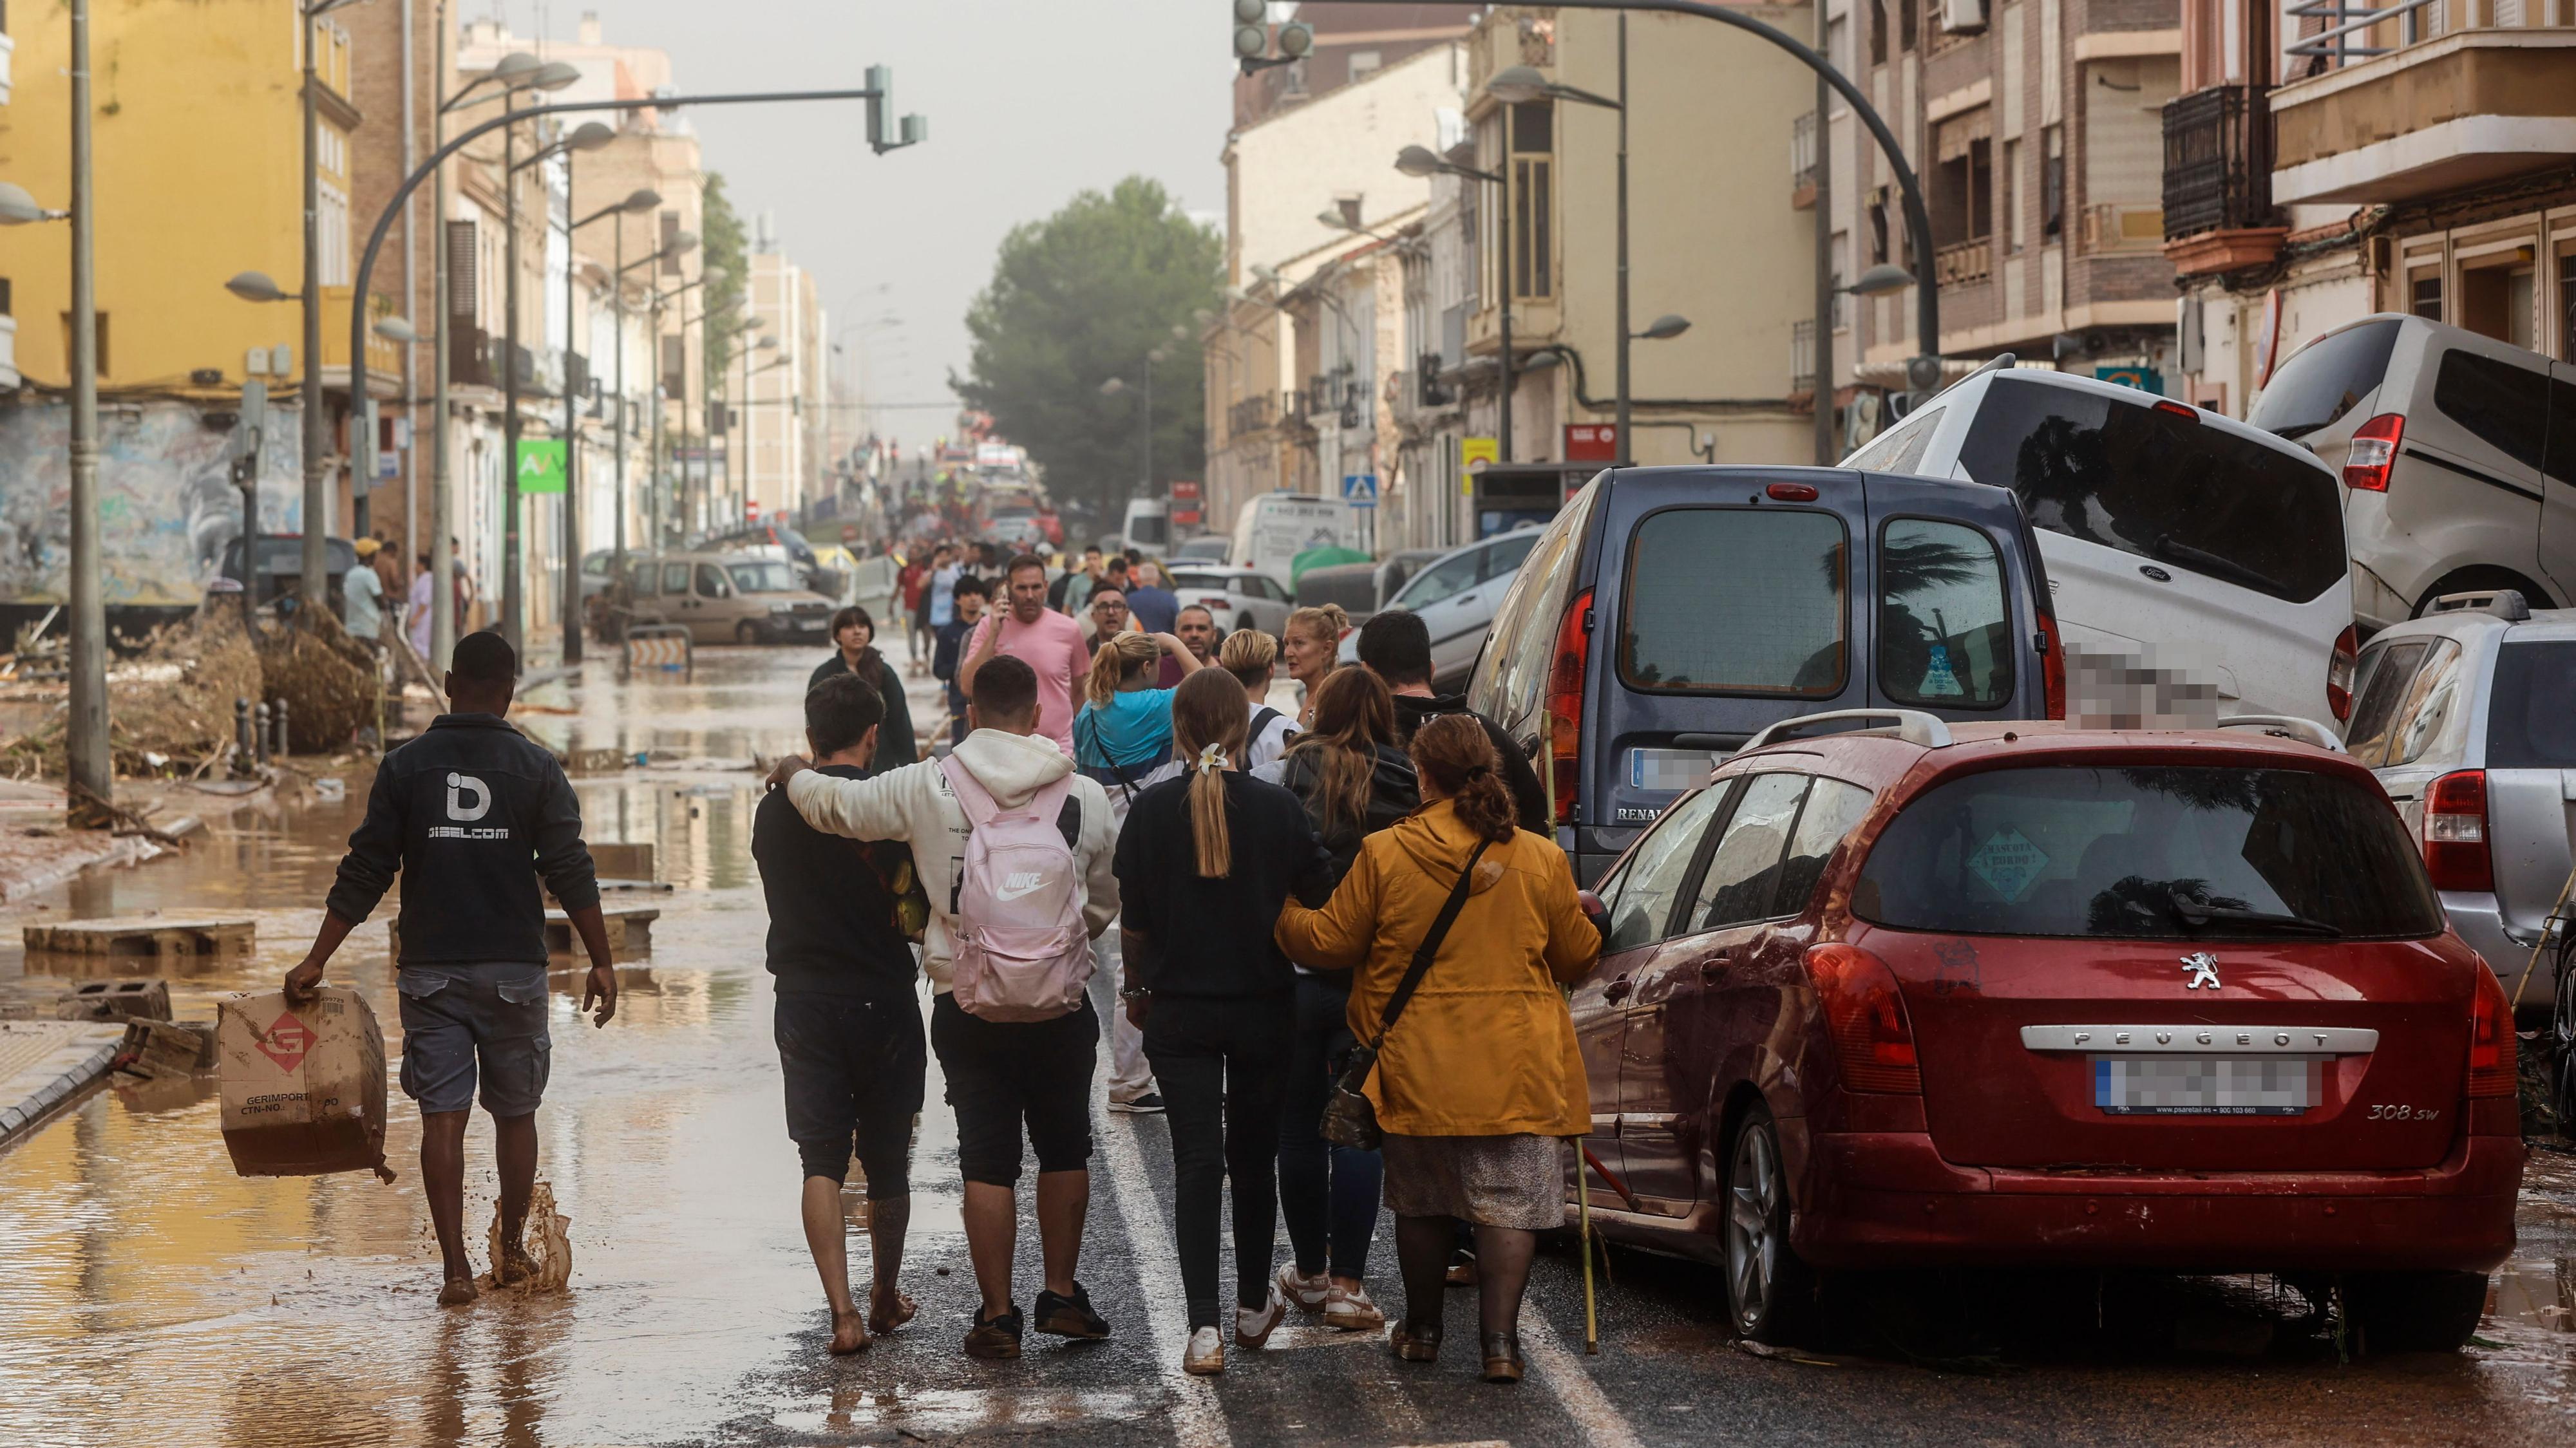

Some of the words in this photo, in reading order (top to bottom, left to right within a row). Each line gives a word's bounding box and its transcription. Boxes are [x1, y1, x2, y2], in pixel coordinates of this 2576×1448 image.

[1005, 872, 1041, 888] NIKE
[2075, 1032, 2327, 1046] PEUGEOT
[2367, 1105, 2411, 1120] 308
